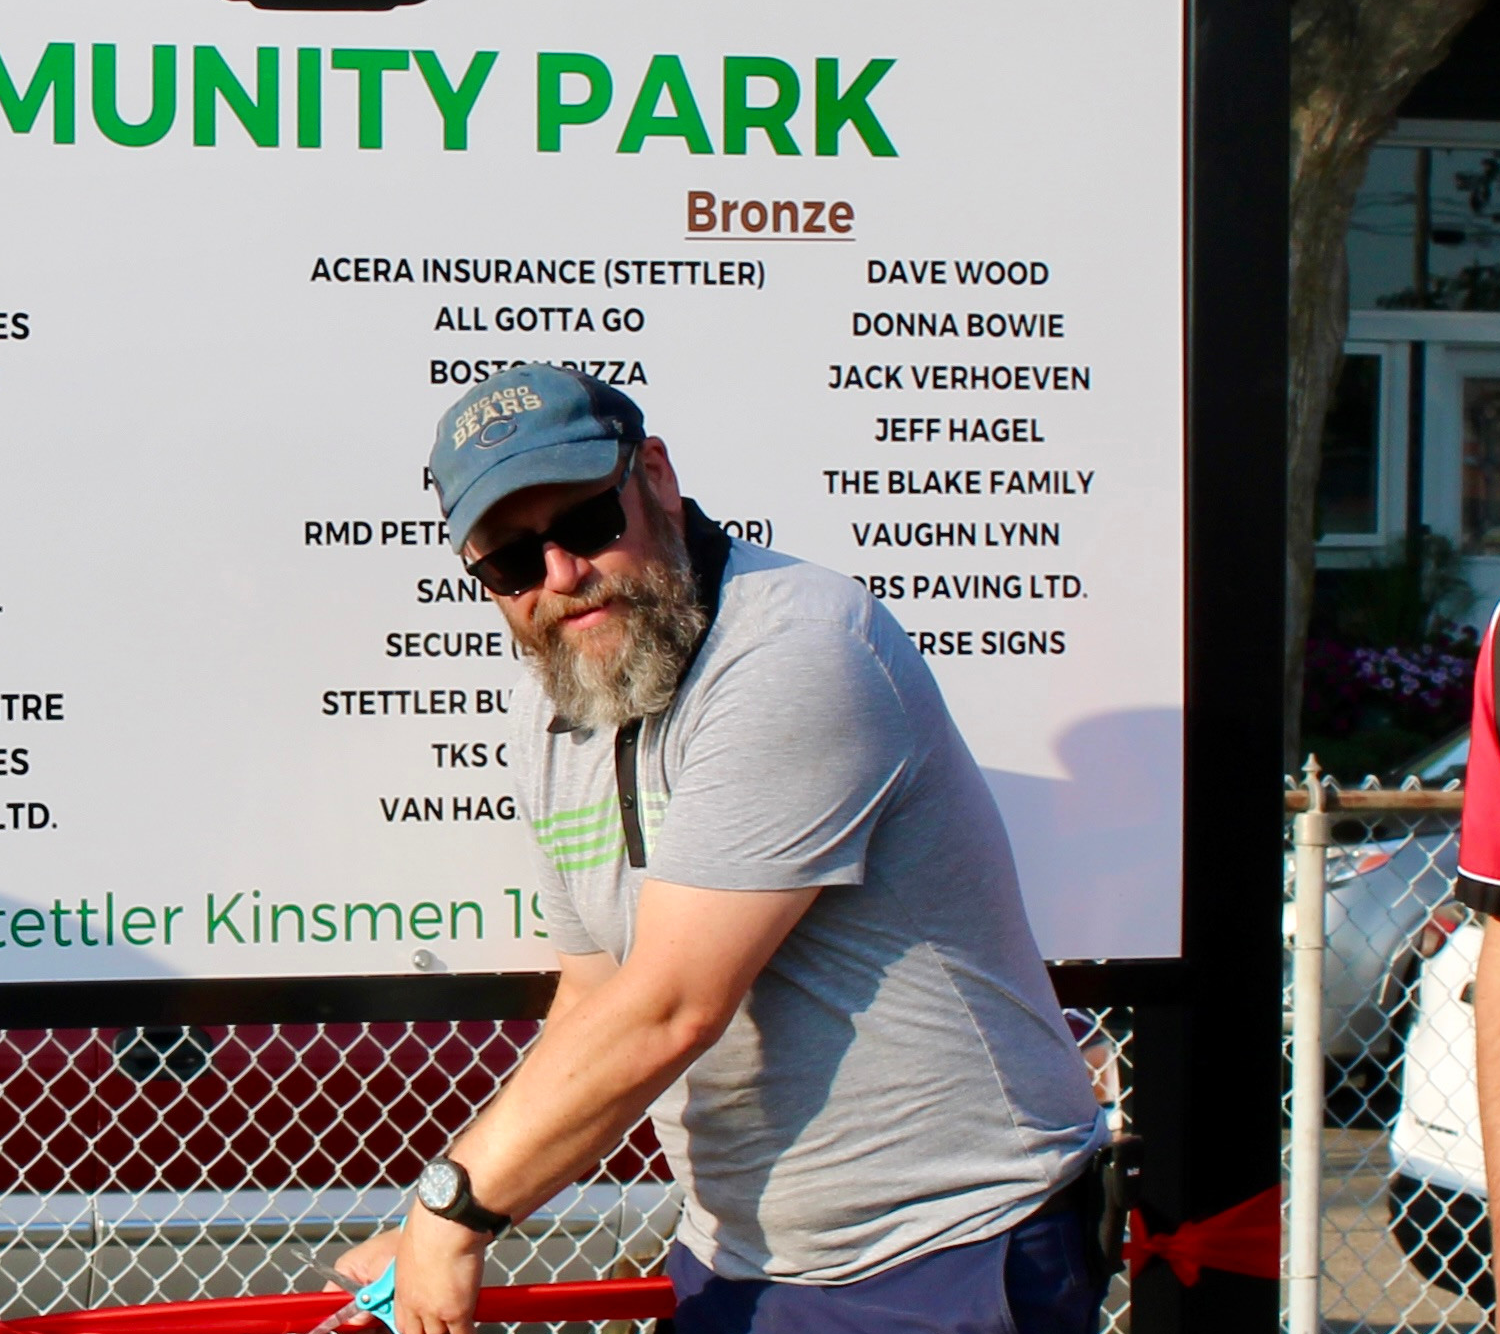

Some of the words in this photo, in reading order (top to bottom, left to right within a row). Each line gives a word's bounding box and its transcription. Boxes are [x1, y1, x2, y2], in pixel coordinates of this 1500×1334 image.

[537, 52, 899, 157] PARK
[688, 191, 854, 233] Bronze
[311, 258, 414, 282] ACERA
[423, 259, 595, 284] INSURANCE
[605, 259, 764, 289] (STETTLER)
[868, 260, 946, 284] DAVE
[955, 261, 1048, 285] WOOD
[435, 307, 487, 331] ALL
[496, 307, 594, 331] GOTTA
[603, 308, 644, 332] GO
[853, 313, 959, 336] DONNA
[968, 314, 1064, 337] BOWIE
[829, 365, 903, 389] JACK
[911, 366, 1089, 390] VERHOEVEN
[455, 386, 529, 427] CHICAGO
[453, 394, 544, 450] BEARS
[875, 418, 941, 442] JEFF
[950, 419, 1044, 442] HAGEL
[823, 471, 879, 494] THE
[889, 471, 981, 494] BLAKE
[991, 471, 1094, 494] FAMILY
[305, 521, 372, 545] RMD
[852, 523, 975, 546] VAUGHN
[986, 523, 1059, 546] LYNN
[914, 575, 1021, 599] PAVING
[1031, 575, 1088, 599] LTD.
[386, 633, 502, 657] SECURE
[982, 631, 1065, 655] SIGNS
[323, 690, 466, 715] STETTLER
[432, 743, 487, 767] TKS
[380, 797, 443, 821] VAN
[453, 796, 520, 820] HAG
[208, 890, 482, 943] Kinsmen
